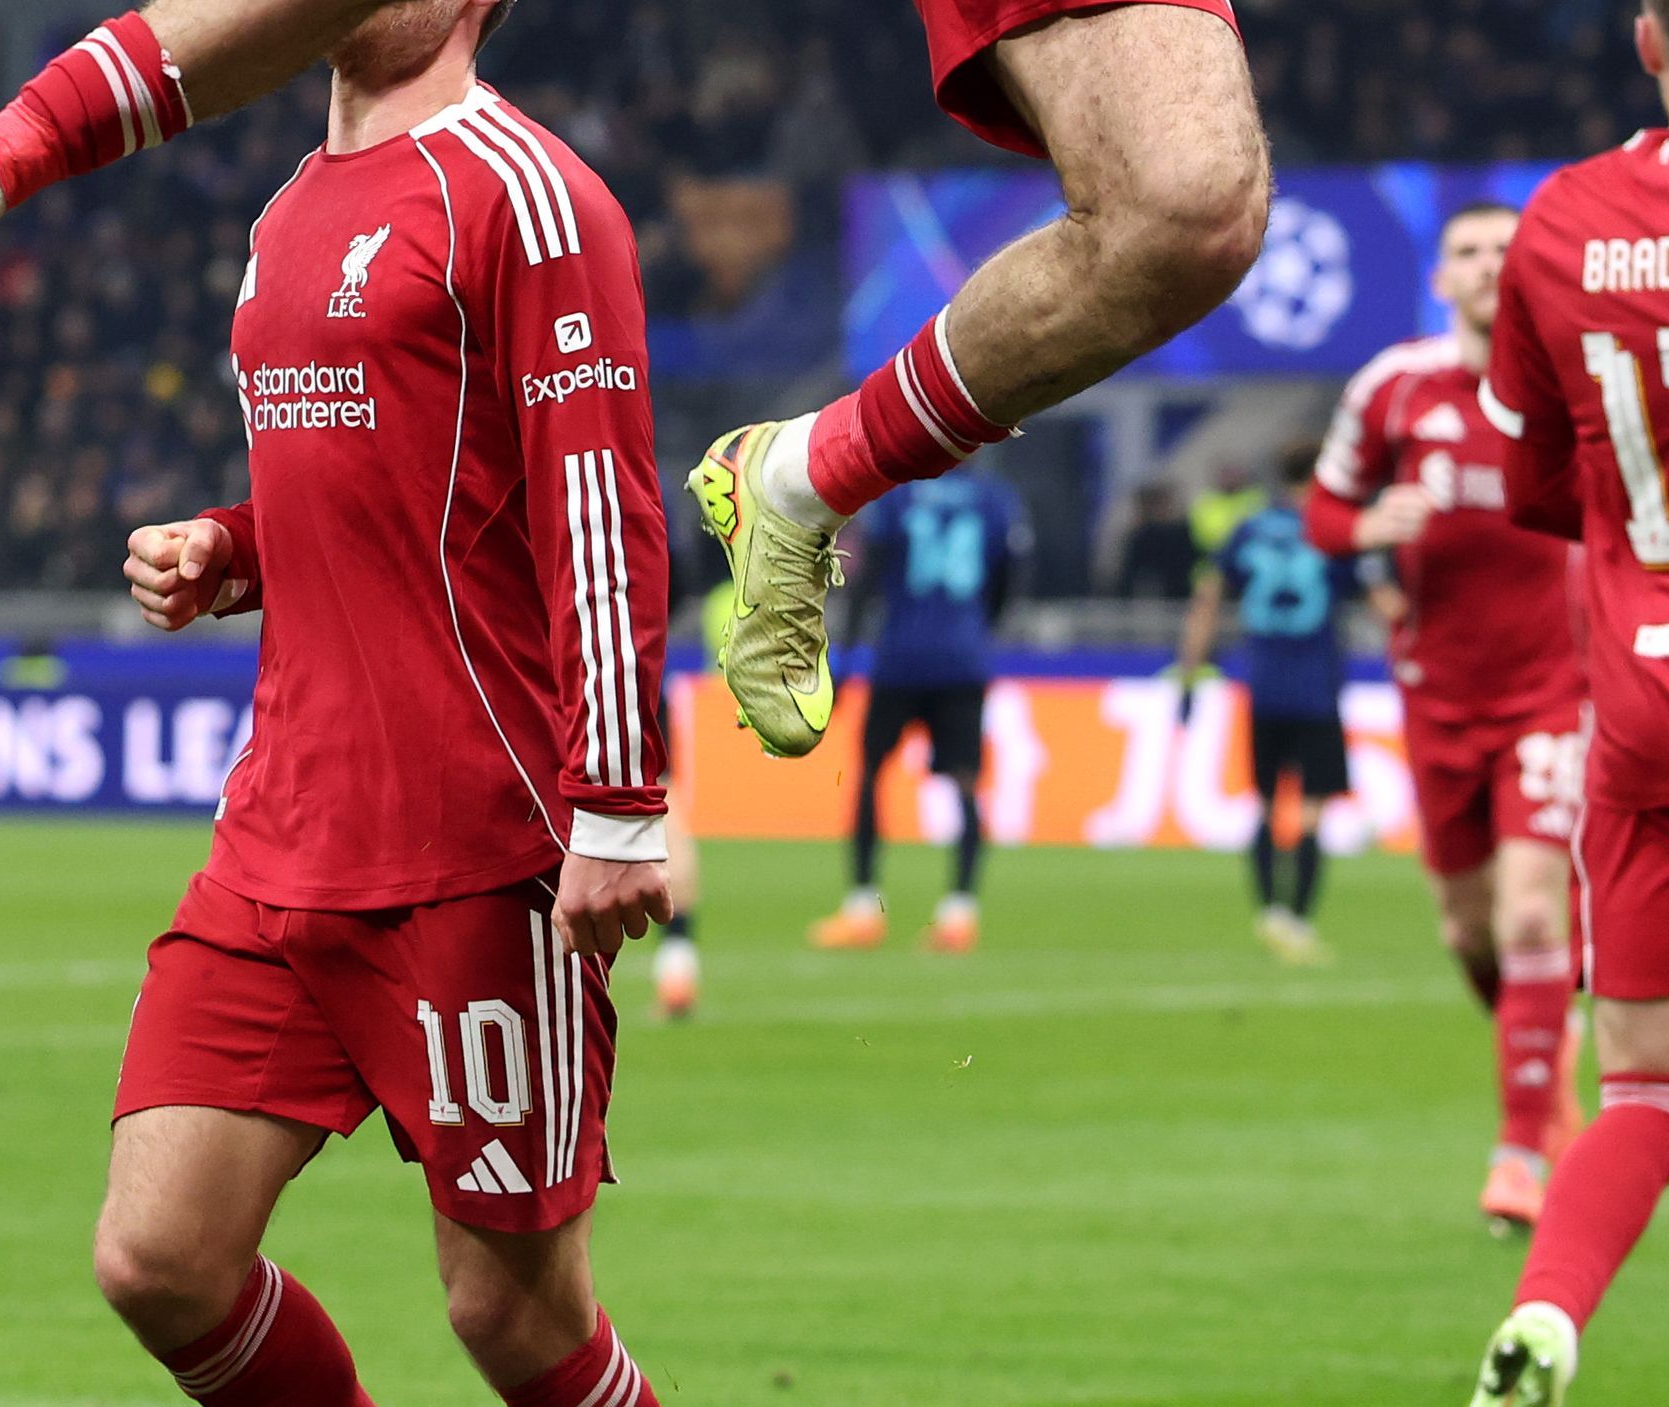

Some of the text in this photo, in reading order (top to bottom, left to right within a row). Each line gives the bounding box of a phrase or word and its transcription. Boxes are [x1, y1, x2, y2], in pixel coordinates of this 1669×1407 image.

[253, 360, 365, 397] standard
[521, 357, 636, 407] Expedia
[254, 395, 376, 431] chartered
[416, 998, 534, 1127] 10
